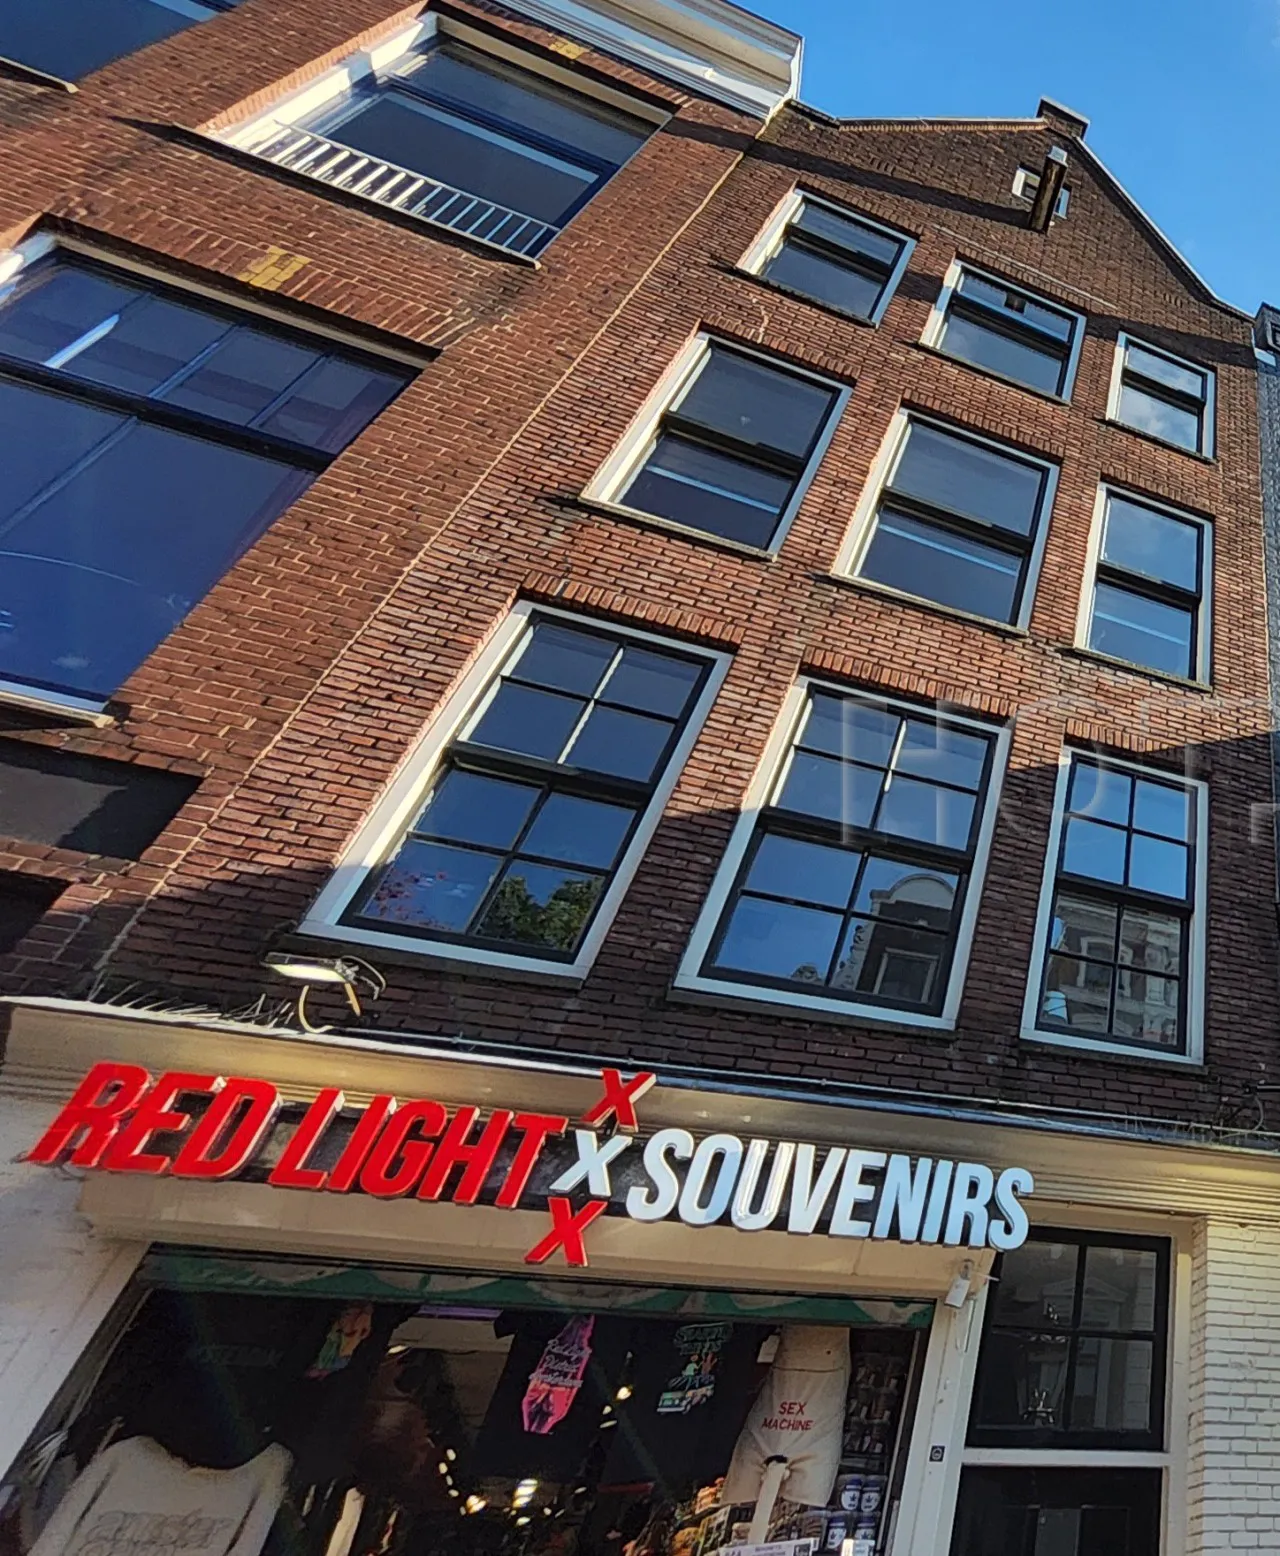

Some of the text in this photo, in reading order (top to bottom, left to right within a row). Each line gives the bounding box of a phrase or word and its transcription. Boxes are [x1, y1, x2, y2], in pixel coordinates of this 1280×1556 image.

[587, 1069, 656, 1131] X
[26, 1062, 1035, 1251] RED LIGHT X SOUVENIRS
[524, 1196, 607, 1267] X
[761, 1417, 814, 1431] MACHINE
[778, 1400, 807, 1415] SEX
